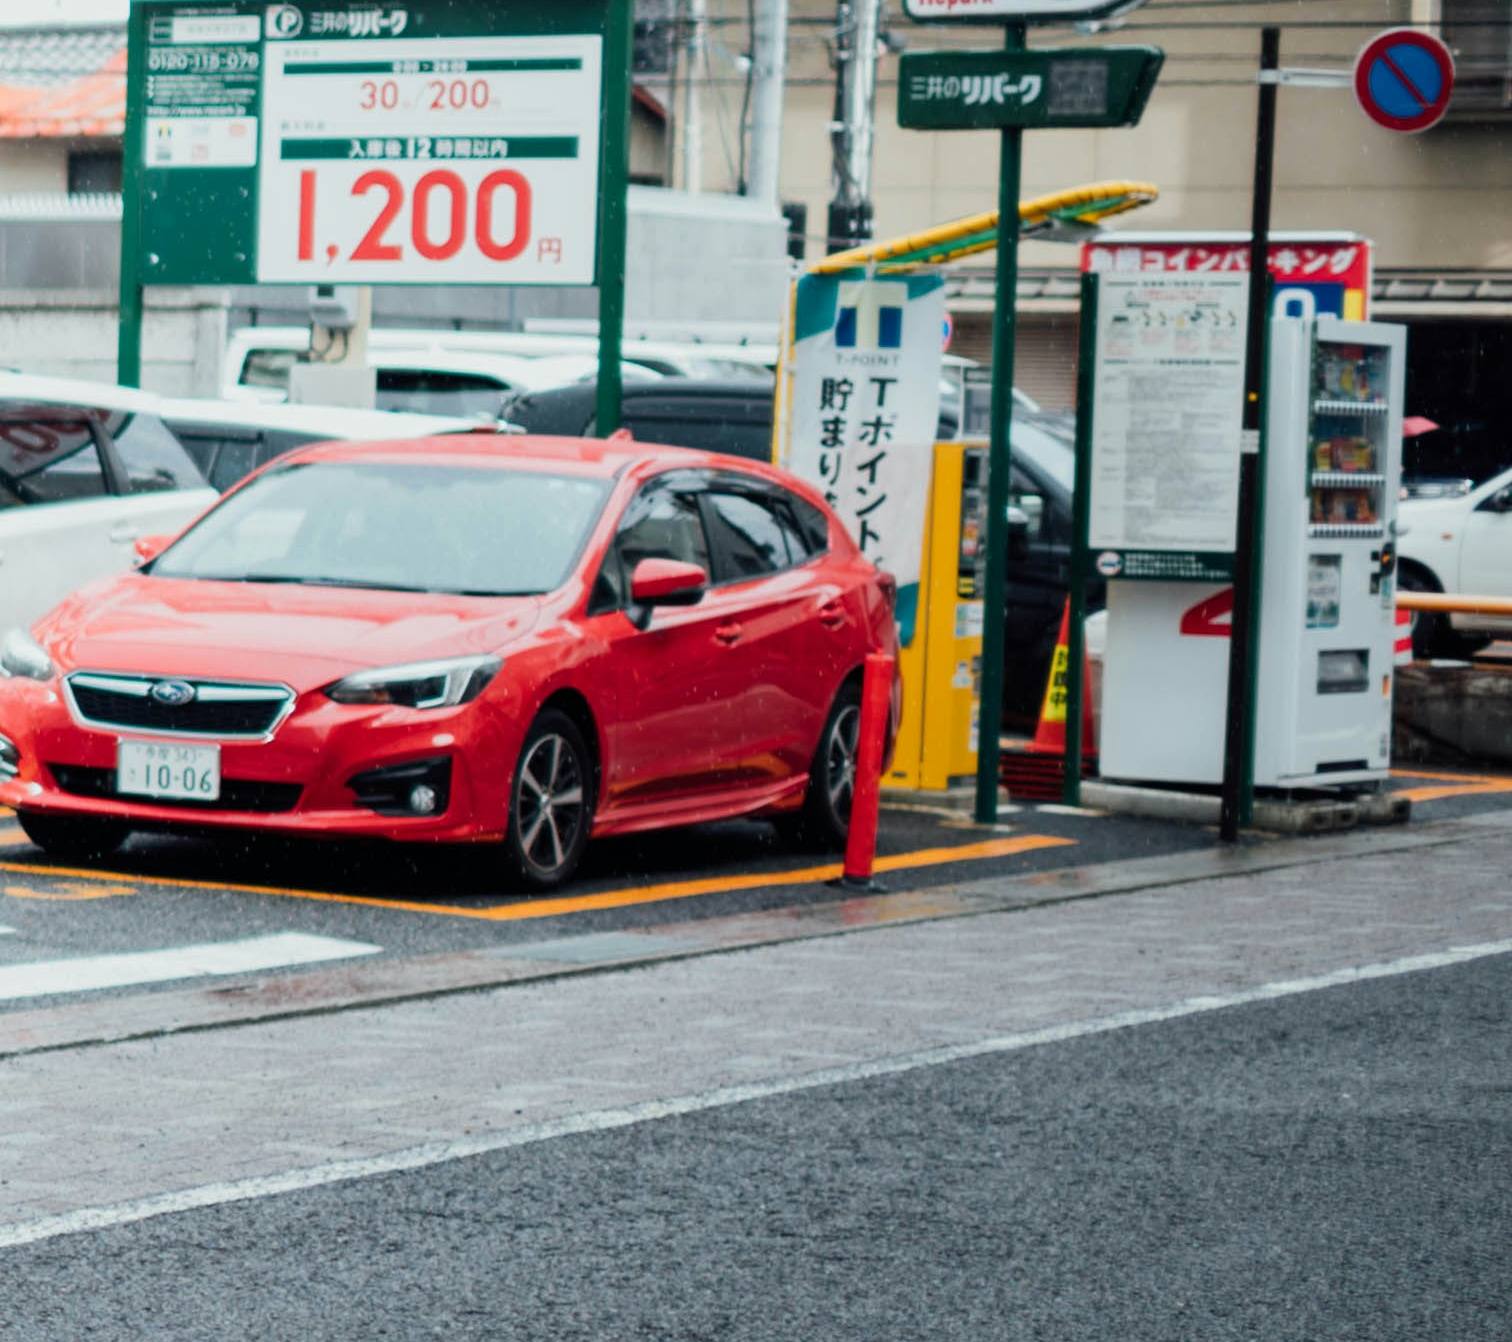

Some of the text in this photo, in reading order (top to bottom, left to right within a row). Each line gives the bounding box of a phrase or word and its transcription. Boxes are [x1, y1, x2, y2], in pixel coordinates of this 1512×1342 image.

[310, 9, 408, 36] 三井のリパーク
[909, 72, 1043, 105] 三井のリパーク
